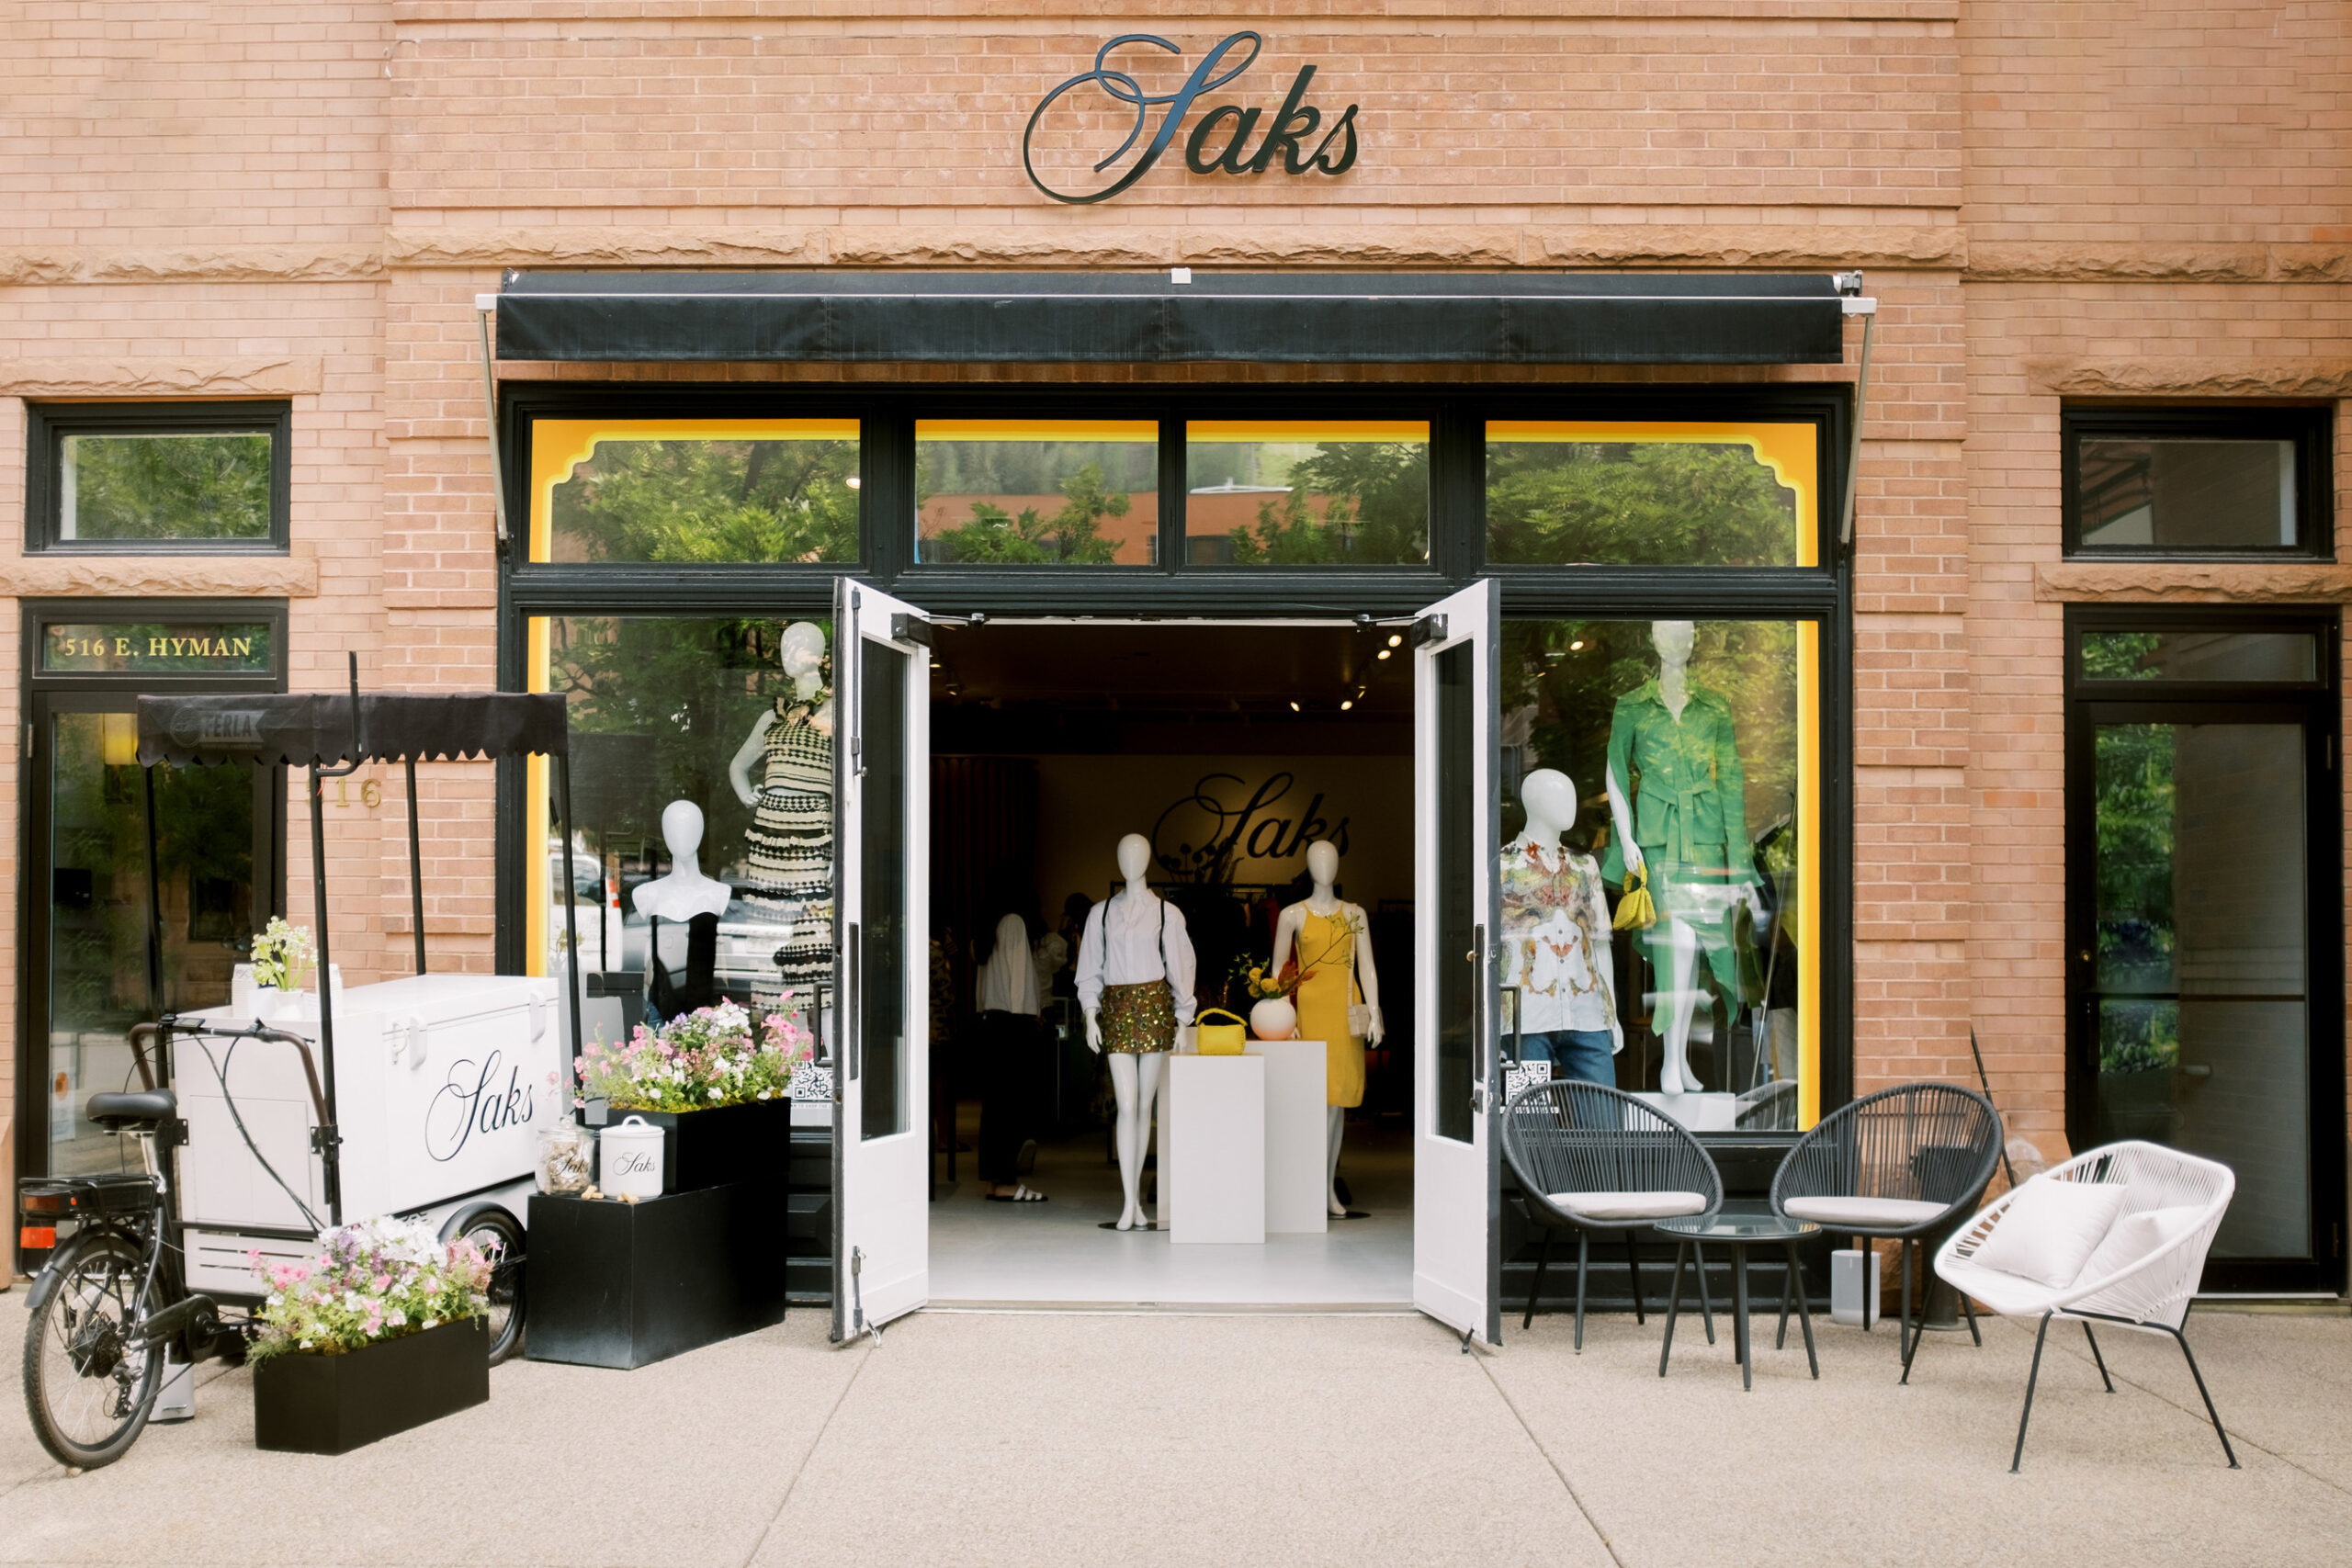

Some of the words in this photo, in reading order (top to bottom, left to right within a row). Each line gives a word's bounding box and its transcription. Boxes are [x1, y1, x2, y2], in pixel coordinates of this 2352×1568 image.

[1023, 29, 1360, 205] Saks
[65, 637, 105, 657] 516
[114, 637, 139, 657] E.
[148, 637, 252, 657] HYMAN
[1151, 771, 1351, 875] Saks
[424, 1049, 534, 1162] Saks
[612, 1151, 656, 1177] Saks
